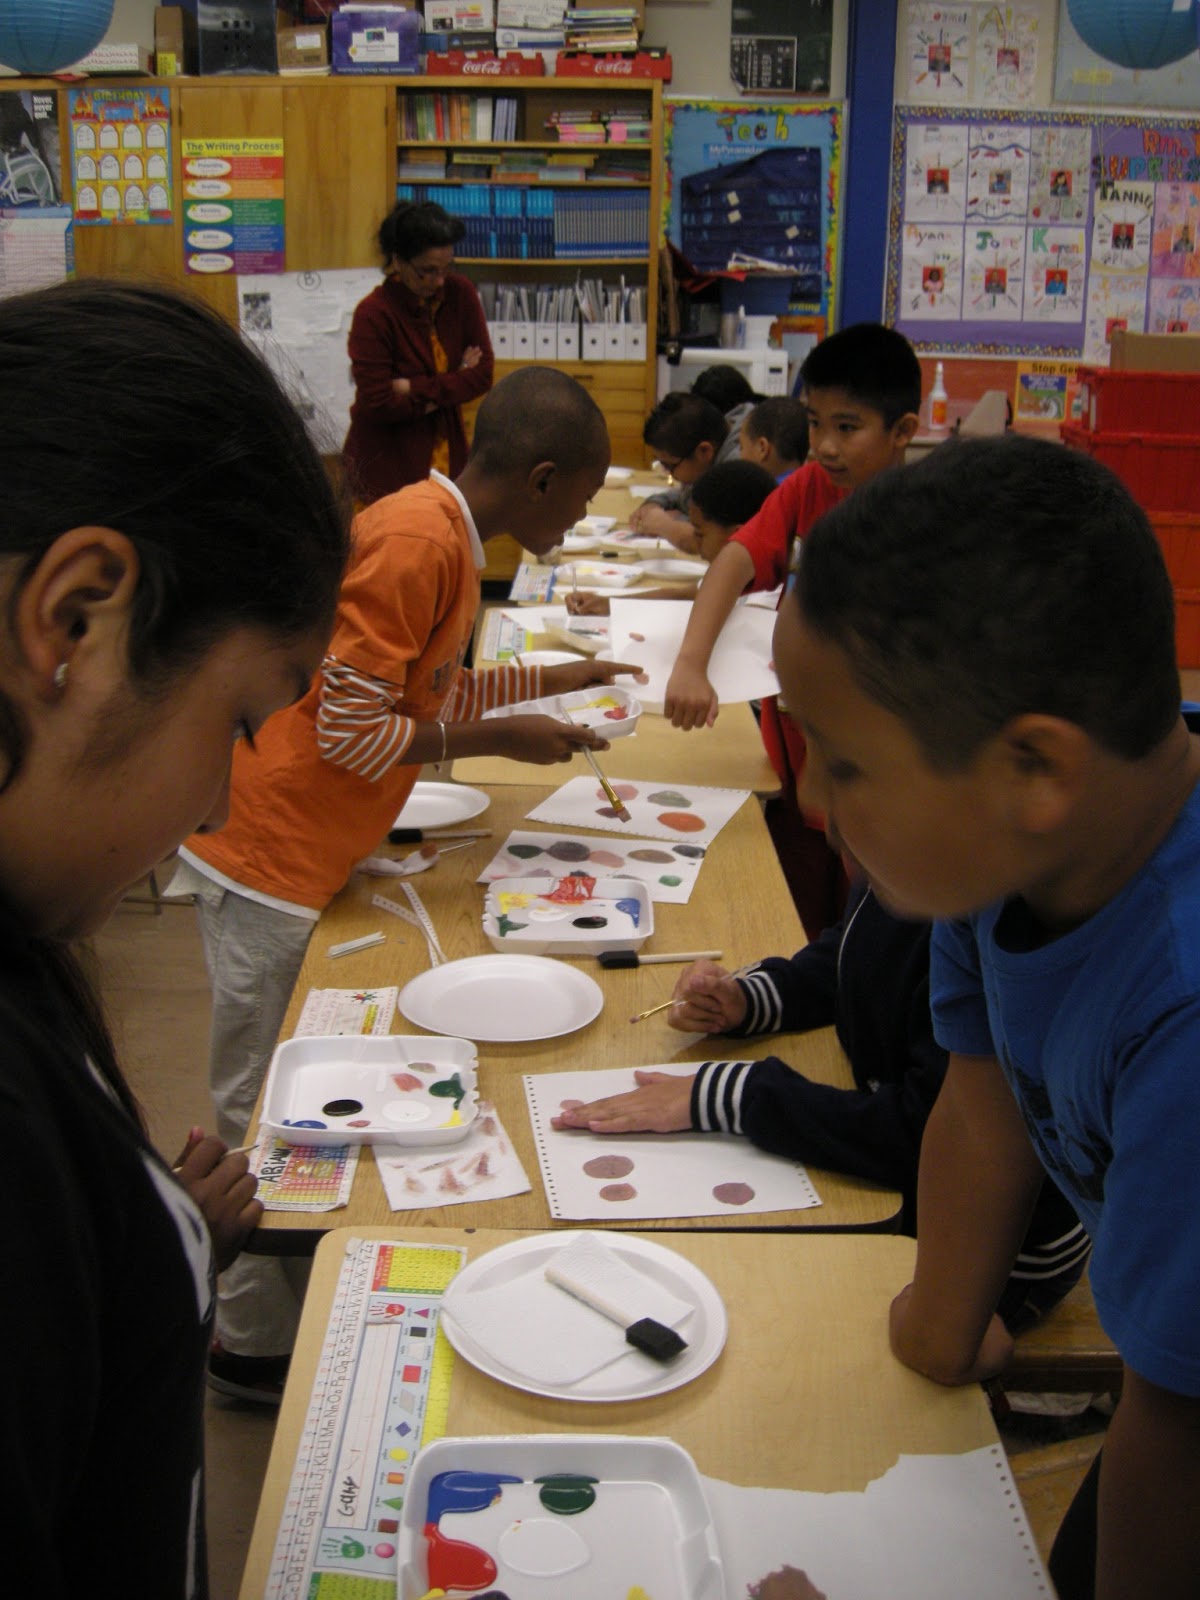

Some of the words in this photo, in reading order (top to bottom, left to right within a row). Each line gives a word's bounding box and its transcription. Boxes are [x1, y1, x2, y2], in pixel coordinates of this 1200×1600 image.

[463, 61, 500, 74] Coca-Cola
[595, 61, 632, 73] Coca-Cola
[186, 142, 203, 150] The
[205, 142, 240, 152] Writing
[1032, 363, 1055, 374] Stop
